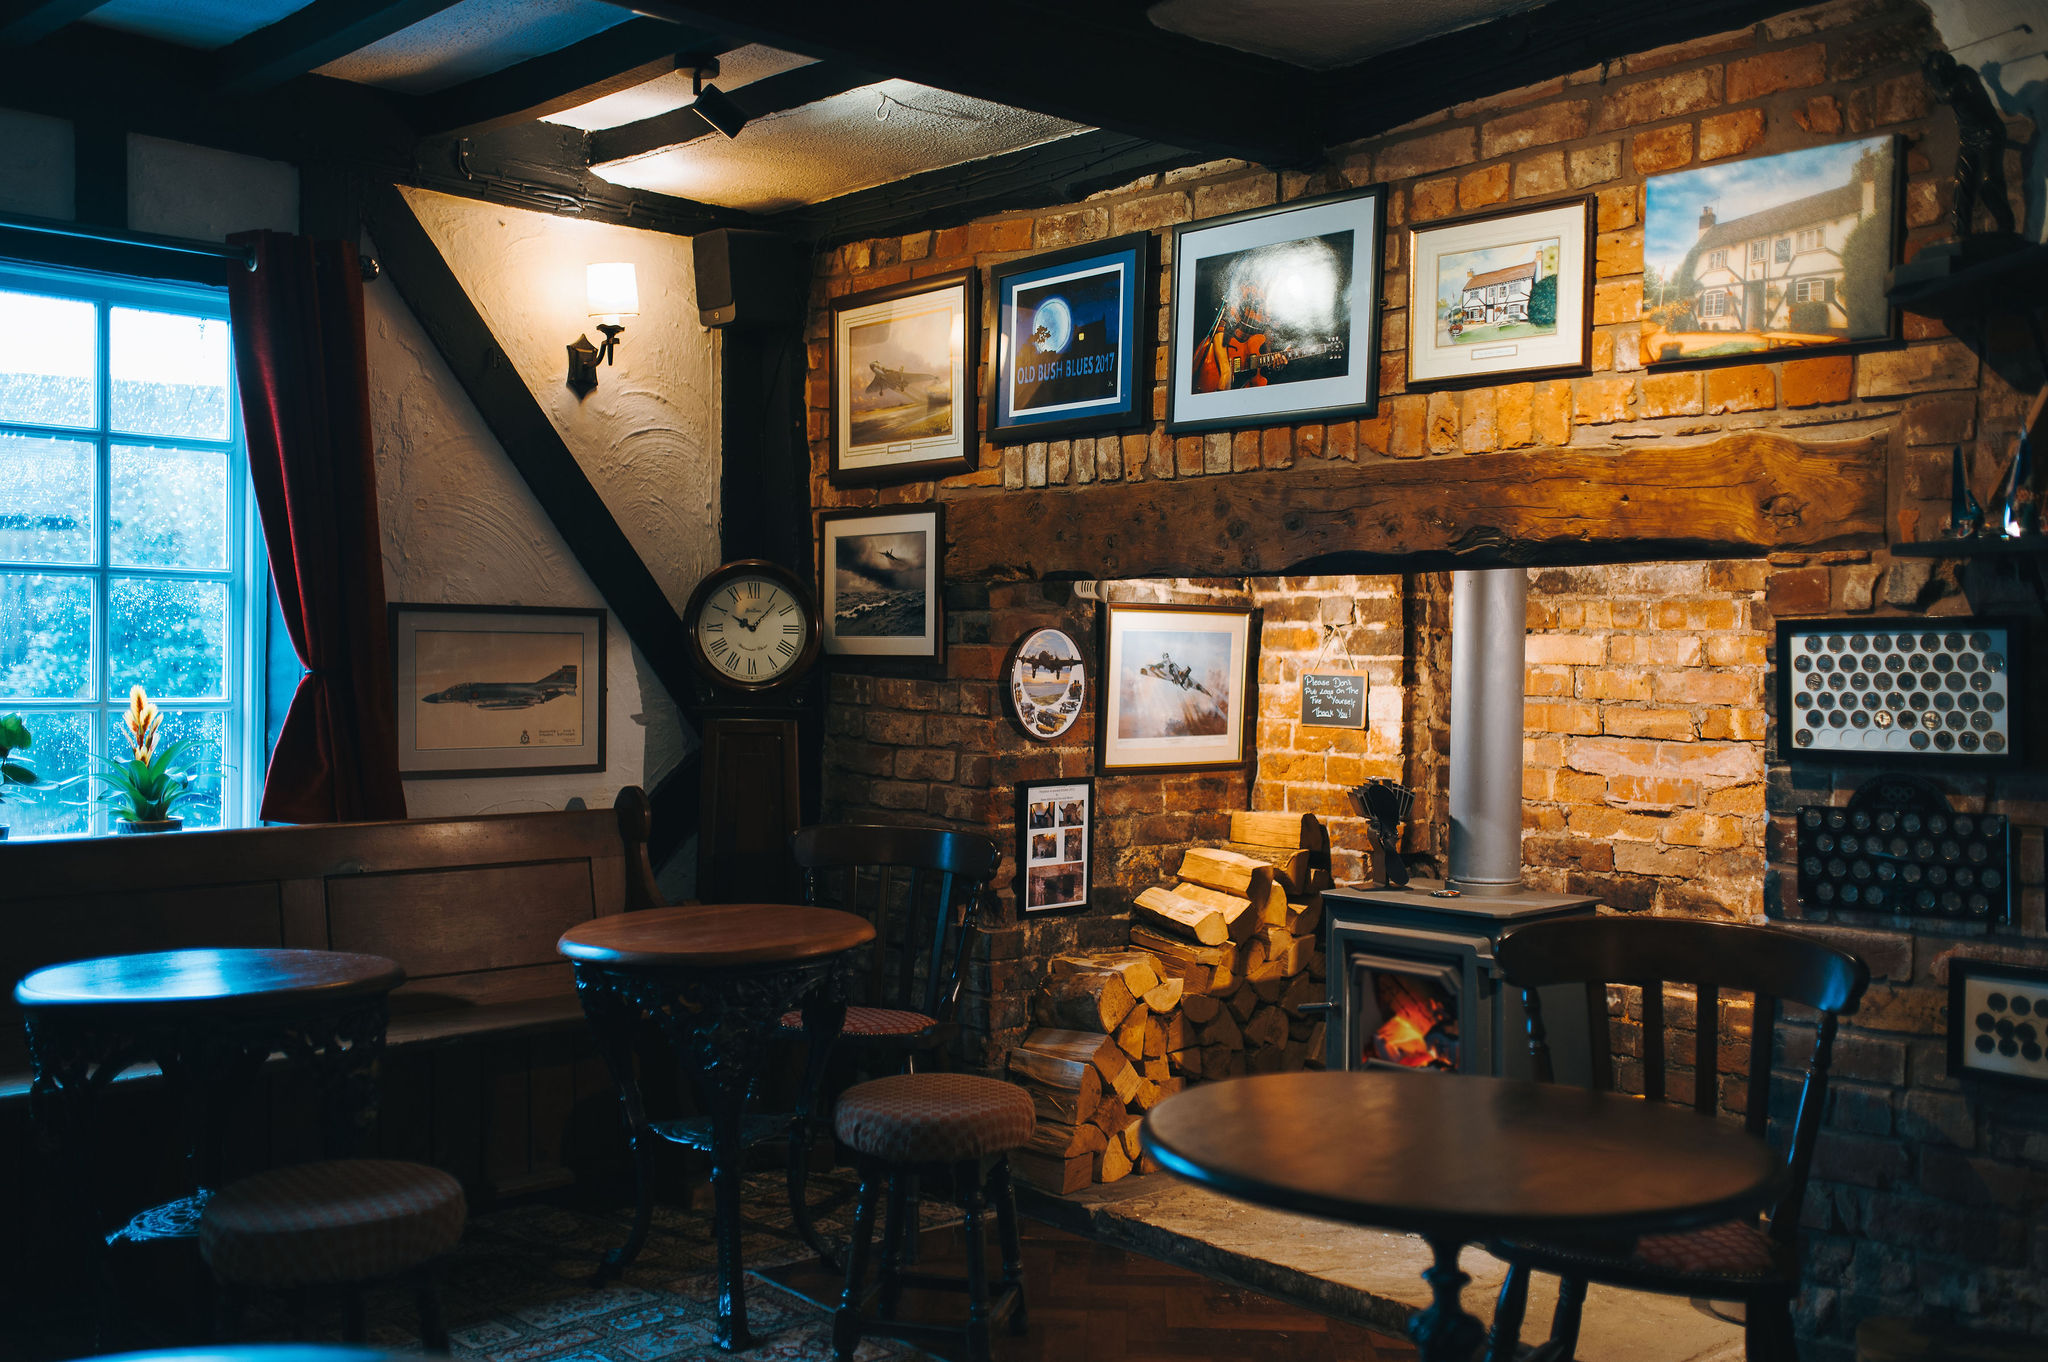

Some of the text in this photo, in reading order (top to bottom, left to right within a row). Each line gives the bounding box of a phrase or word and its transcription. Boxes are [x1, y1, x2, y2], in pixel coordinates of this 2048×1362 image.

[1017, 352, 1115, 384] OLD BUSH BLUES 2017
[1304, 674, 1330, 686] Please
[1304, 687, 1317, 695] Put
[1346, 686, 1359, 695] The
[1311, 707, 1334, 717] Thank
